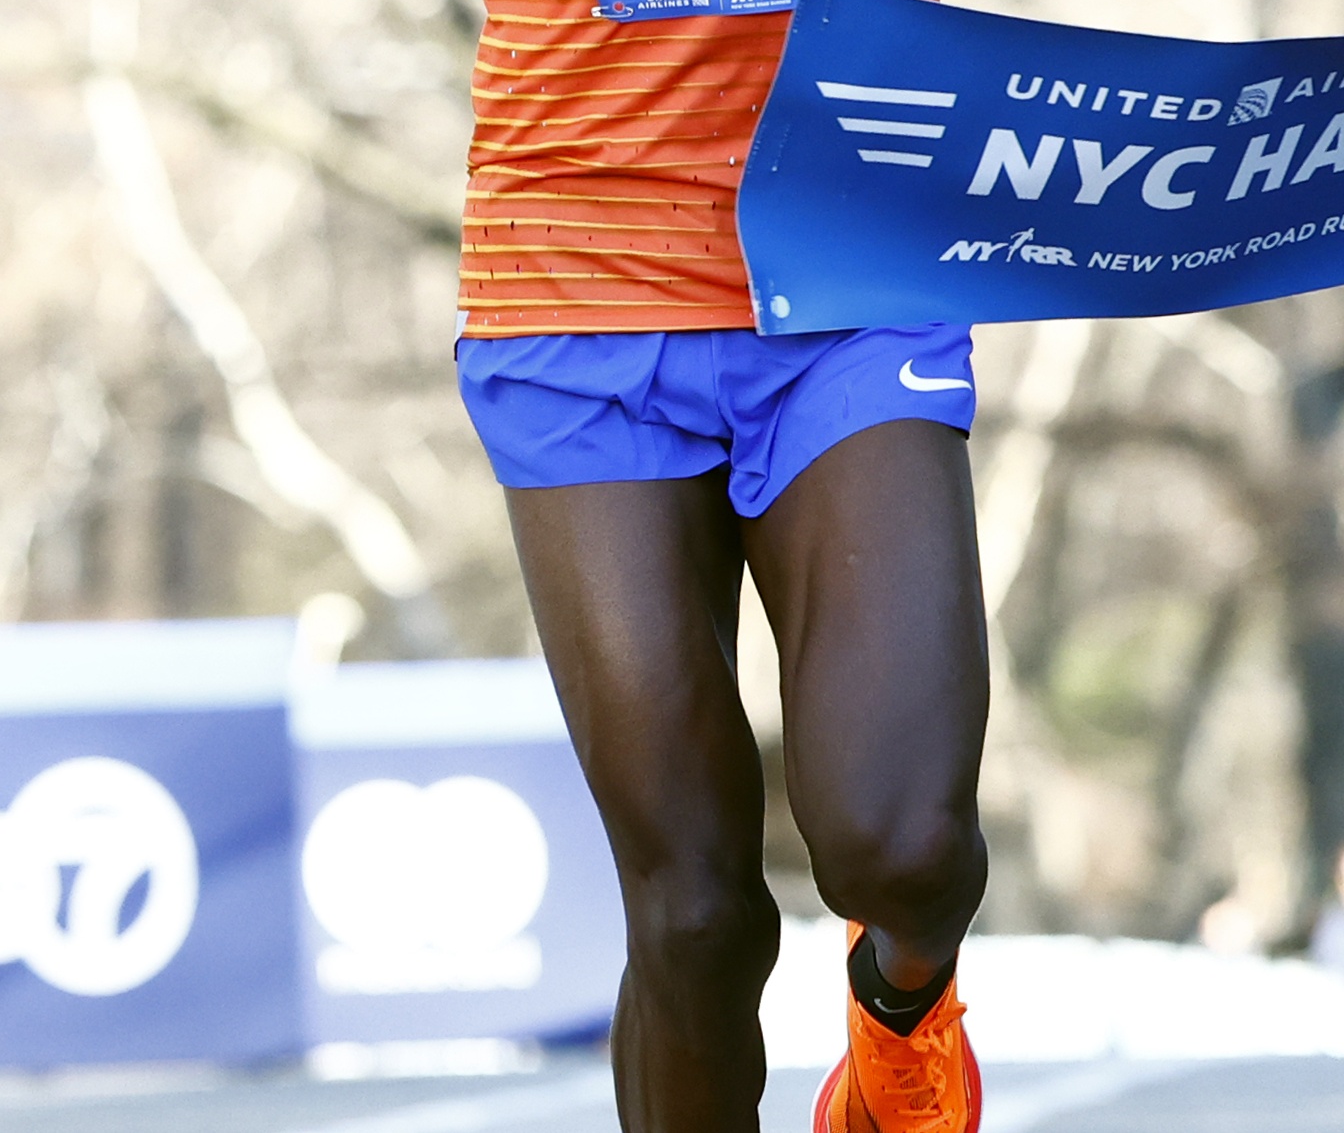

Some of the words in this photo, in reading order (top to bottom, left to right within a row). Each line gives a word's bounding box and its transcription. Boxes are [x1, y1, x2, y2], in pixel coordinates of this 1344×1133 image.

[637, 0, 690, 10] AIRLINES
[1006, 73, 1222, 121] UNITED
[966, 128, 1216, 210] NYC
[938, 239, 1078, 266] NYRR
[1087, 251, 1163, 272] NEW
[1170, 242, 1242, 270] YORK
[1244, 223, 1316, 255] ROAD
